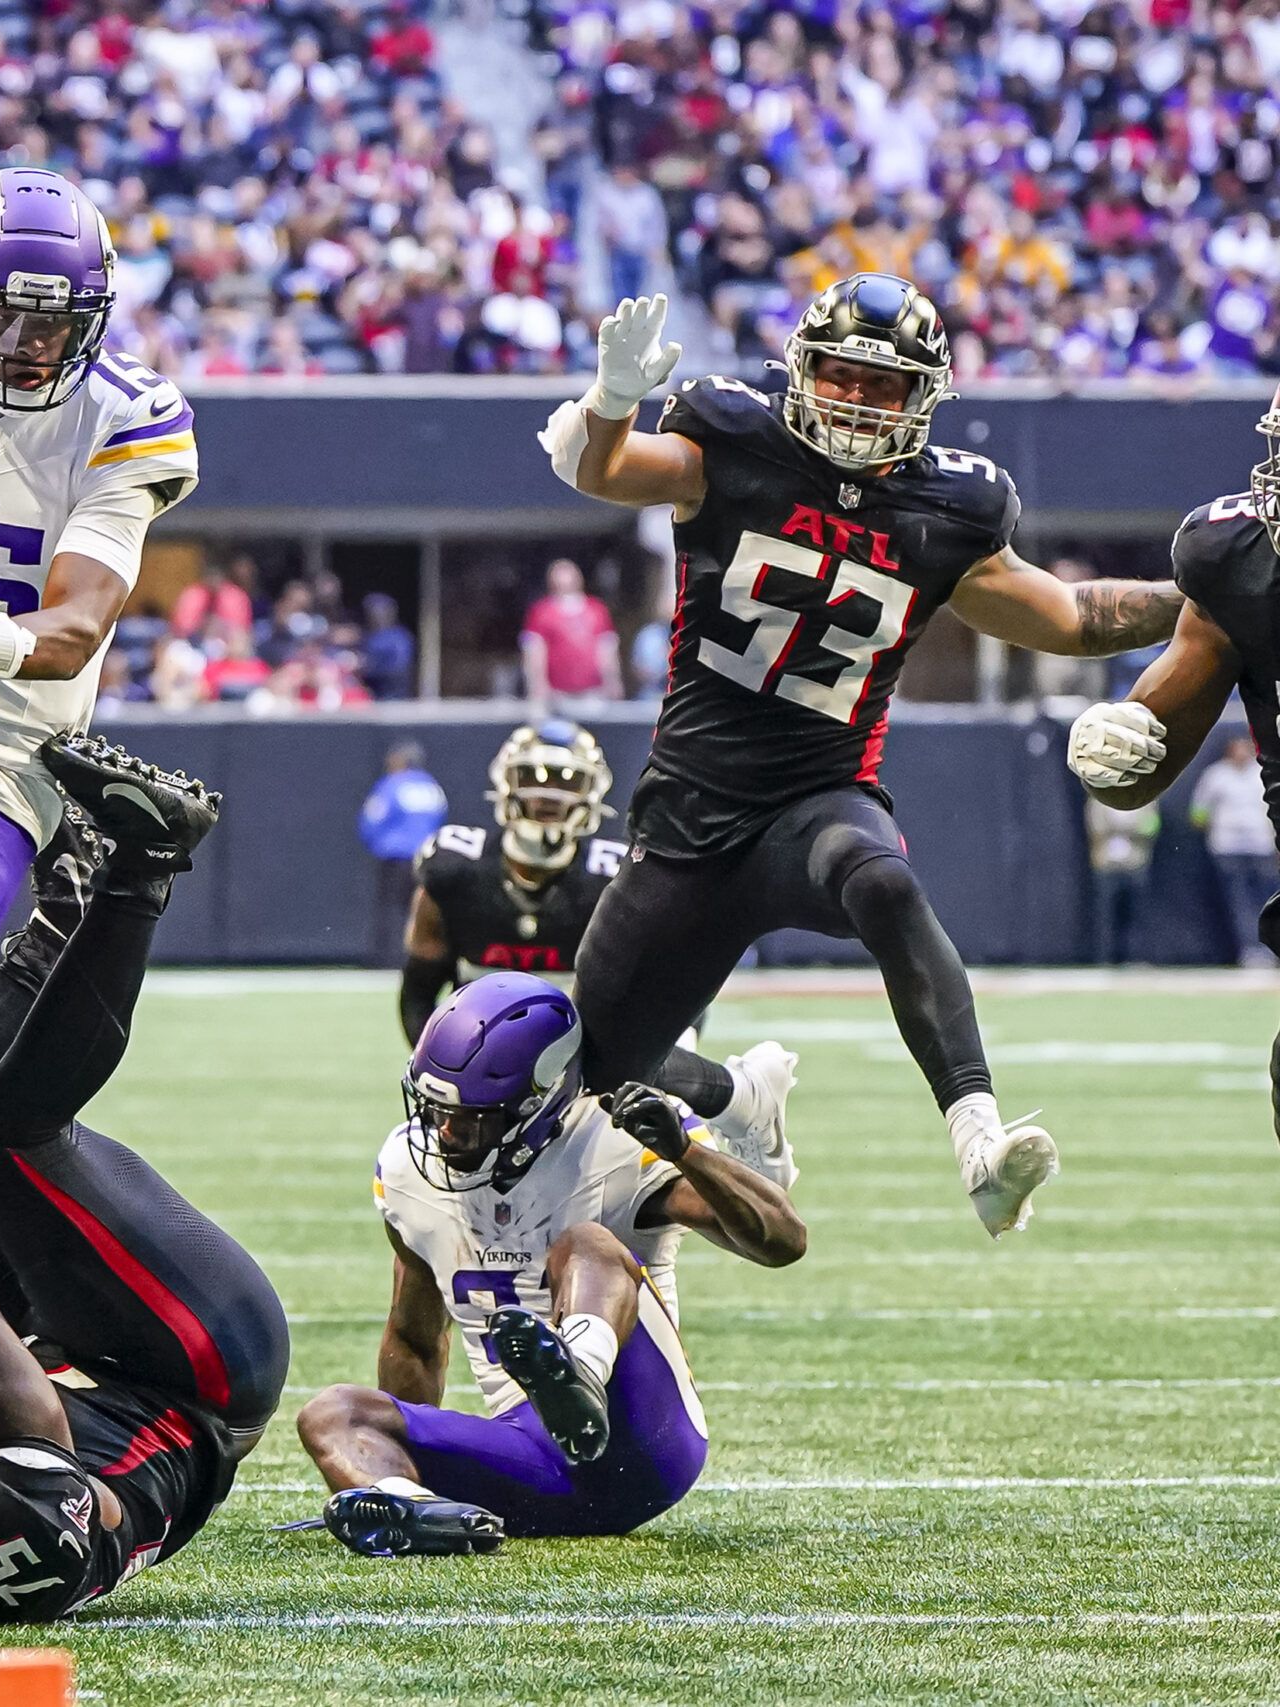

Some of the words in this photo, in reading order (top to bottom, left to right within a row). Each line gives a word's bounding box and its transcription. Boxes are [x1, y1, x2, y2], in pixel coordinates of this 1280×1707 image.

[856, 340, 884, 352] ATL
[781, 503, 900, 571] ATL
[697, 530, 919, 728] 53
[145, 848, 177, 859] ALPHA
